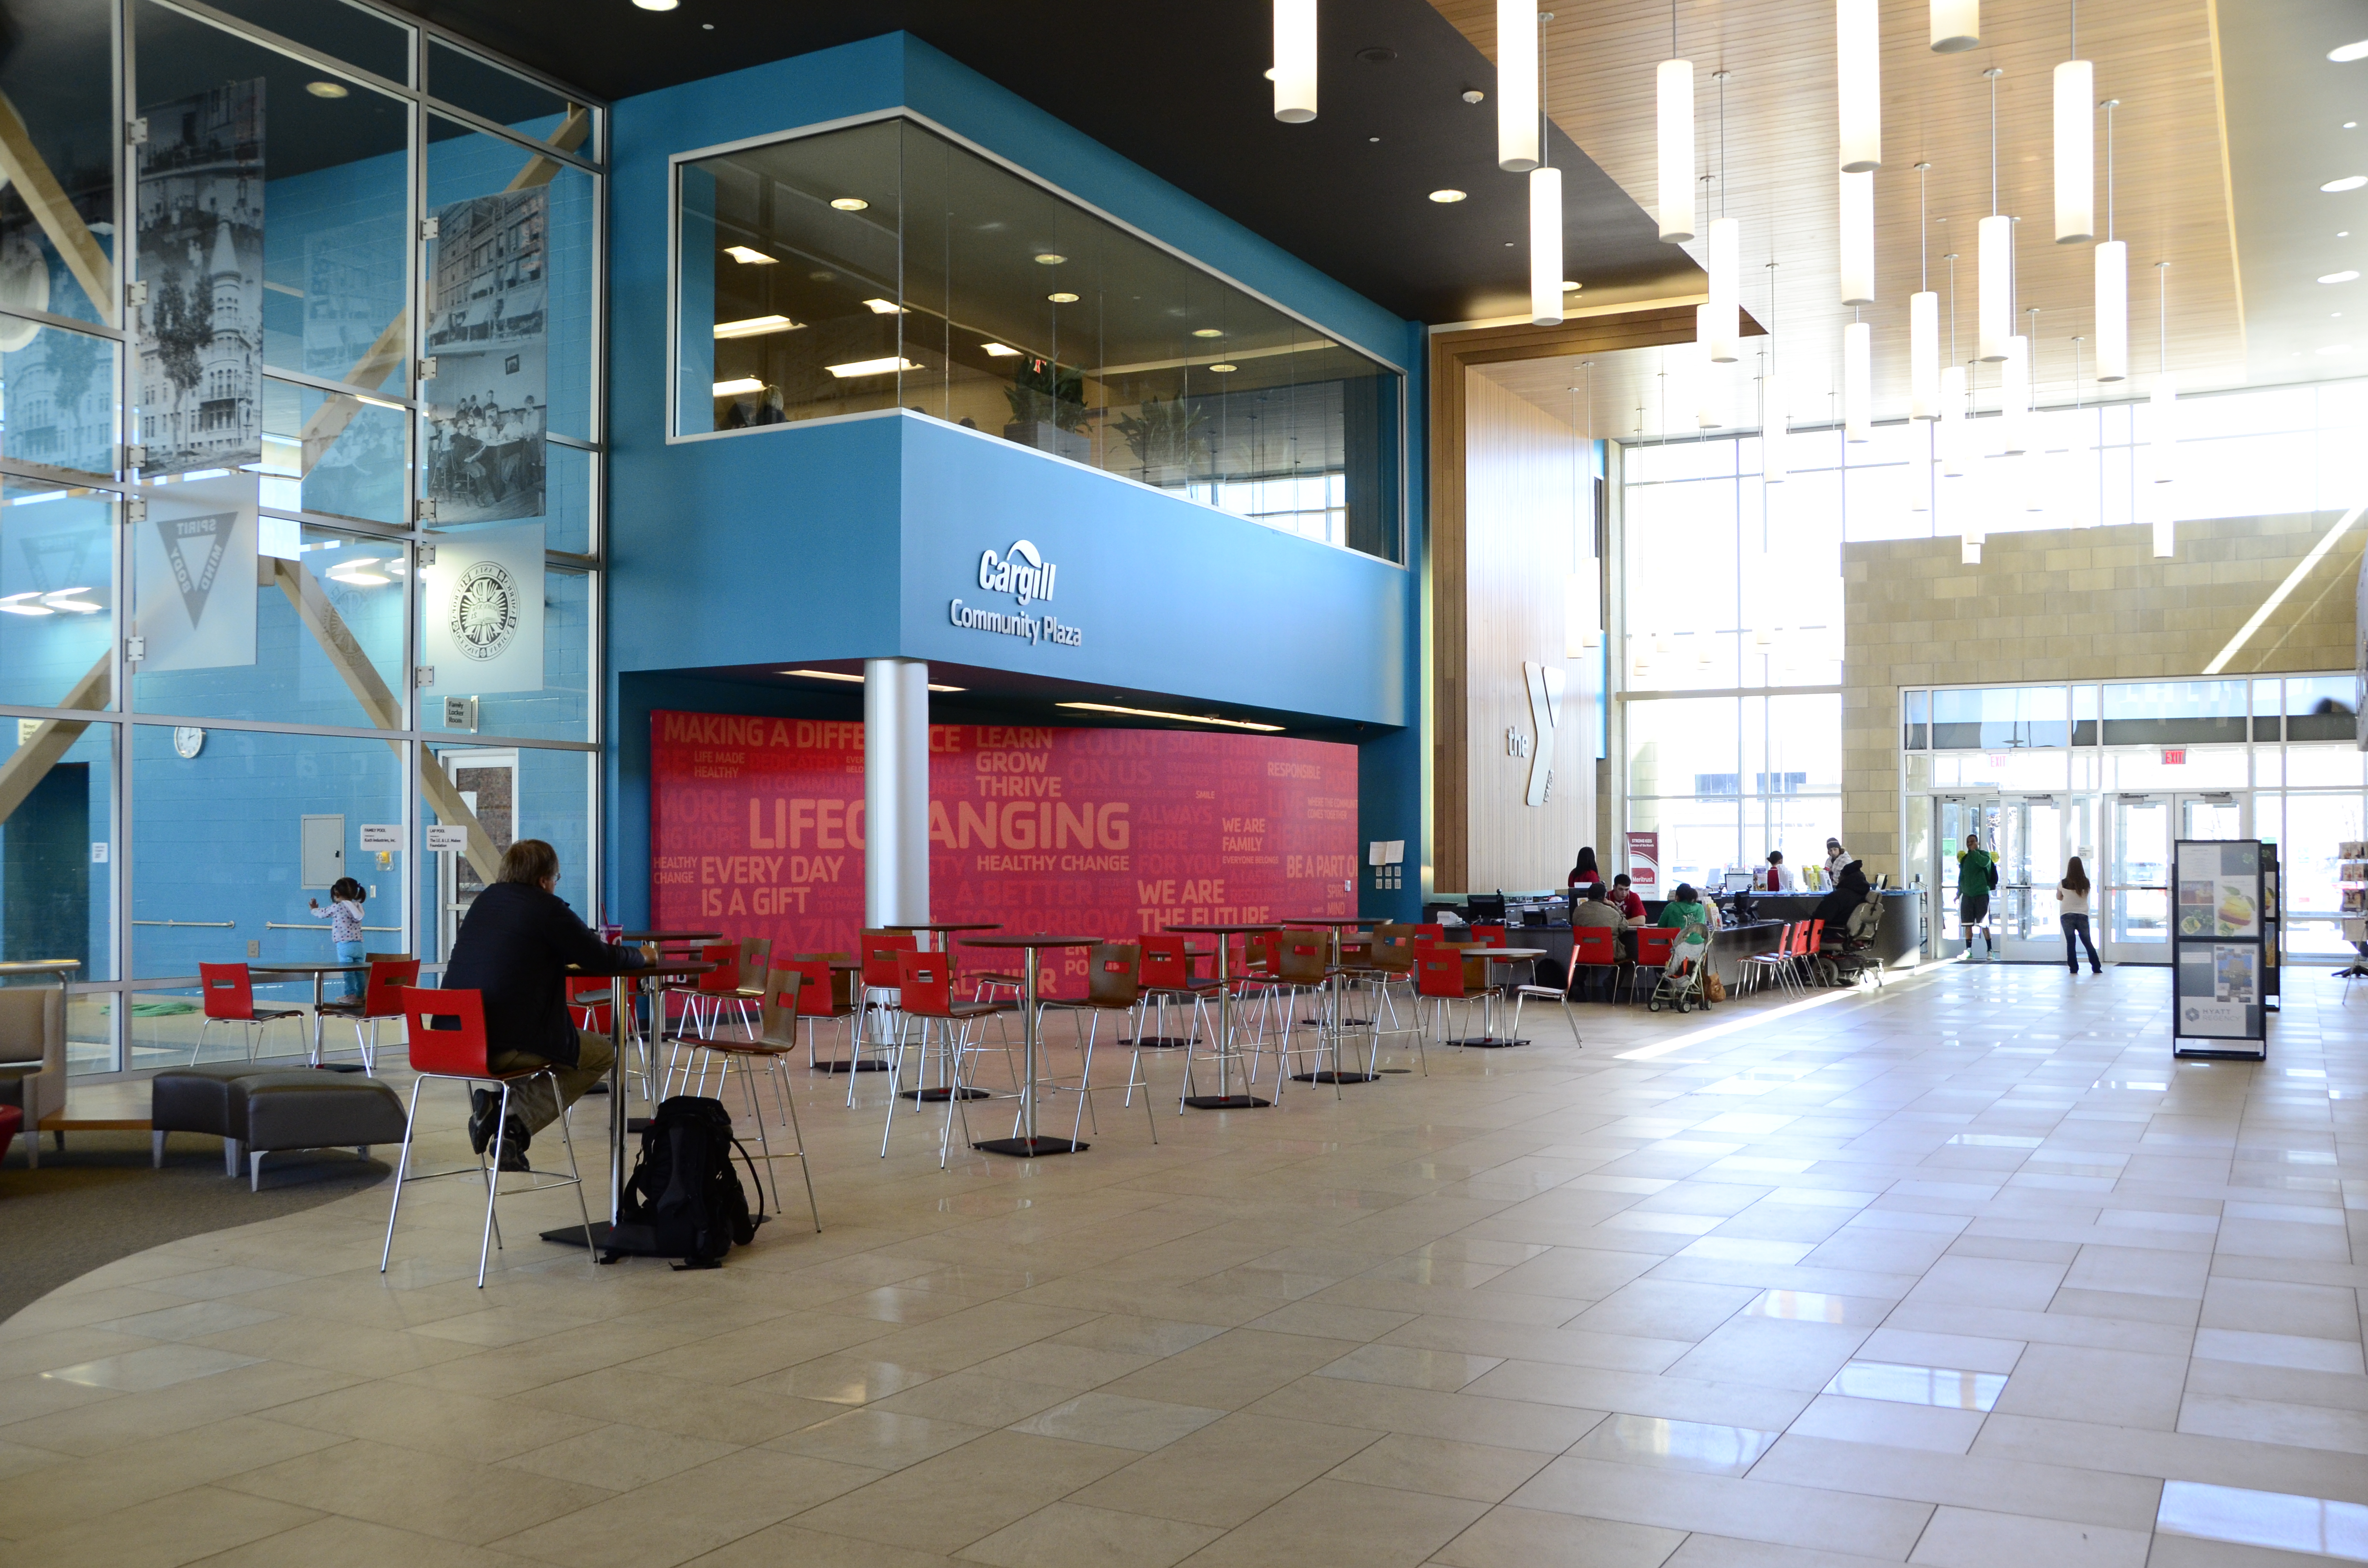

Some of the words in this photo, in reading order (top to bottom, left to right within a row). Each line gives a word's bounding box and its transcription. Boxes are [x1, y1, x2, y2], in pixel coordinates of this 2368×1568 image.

[979, 549, 1057, 606] Cargill
[950, 598, 1041, 646] Community
[1042, 615, 1082, 647] Plaza
[448, 701, 464, 710] Family
[664, 714, 764, 747] MAKING
[769, 721, 790, 747] A
[796, 721, 962, 753] DIFFECE
[976, 727, 1053, 751] LEARN
[1507, 724, 1529, 758] the
[694, 750, 713, 764] LIFE
[715, 752, 745, 765] MADE
[975, 750, 1049, 773] GROW
[1991, 756, 2006, 767] EXIT
[2165, 750, 2184, 764] EXIT
[694, 765, 740, 778] HEALTHY
[1267, 761, 1321, 780] RESPONSIBLE
[974, 775, 1062, 798] THRIVE
[1195, 790, 1216, 799] SMILE
[1307, 796, 1324, 808] WHERE
[749, 797, 1130, 851] LIFECANGING
[1222, 817, 1242, 833] WE
[1243, 818, 1266, 833] ARE
[1222, 836, 1263, 852] FAMILY
[653, 856, 698, 869] HEALTHY
[976, 854, 1057, 872] HEALTHY
[1061, 854, 1130, 872] CHANGE
[1222, 855, 1254, 865] EVERYONE
[1255, 856, 1279, 865] BELONGS
[1286, 855, 1303, 879] BE
[1305, 855, 1315, 878] A
[1316, 855, 1345, 878] PART
[653, 870, 694, 884] CHANGE
[701, 855, 784, 885] EVERY
[789, 855, 845, 884] DAY
[1136, 879, 1177, 906] WE
[1181, 879, 1225, 905] ARE
[702, 887, 723, 918] IS
[727, 887, 748, 917] A
[752, 886, 811, 916] GIFT
[1327, 901, 1345, 916] MIND
